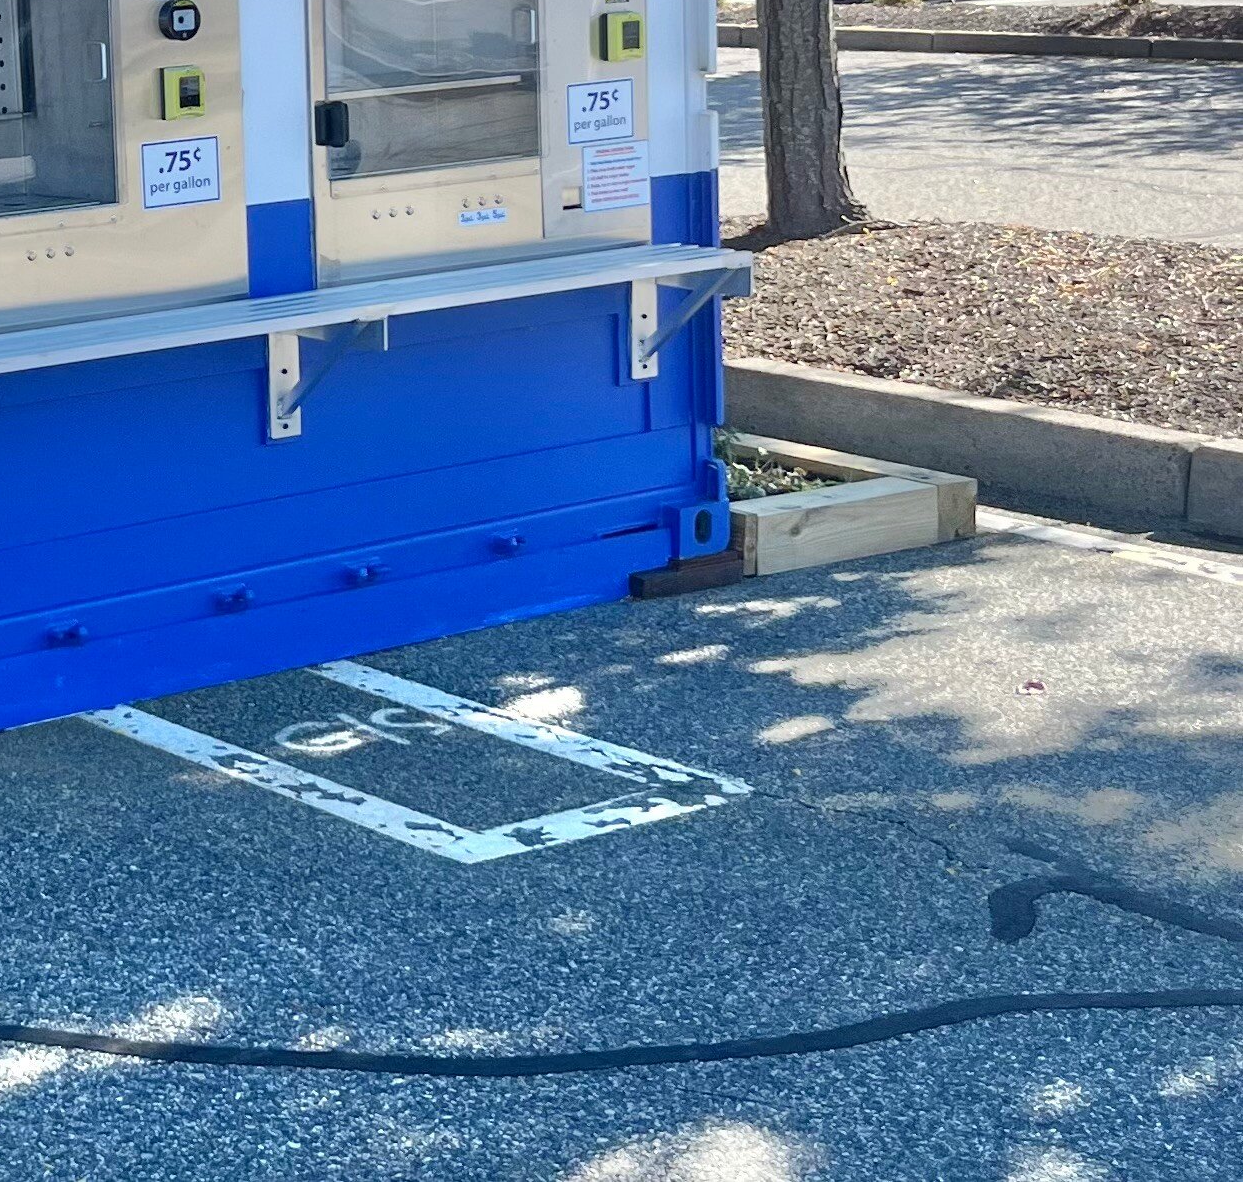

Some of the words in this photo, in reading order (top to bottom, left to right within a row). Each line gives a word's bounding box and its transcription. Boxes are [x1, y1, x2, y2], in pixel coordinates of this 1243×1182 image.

[582, 89, 619, 112] .75¢
[574, 120, 591, 133] per
[594, 115, 626, 131] gallon
[159, 147, 201, 173] .75¢
[150, 182, 170, 196] per
[173, 175, 211, 194] gallon
